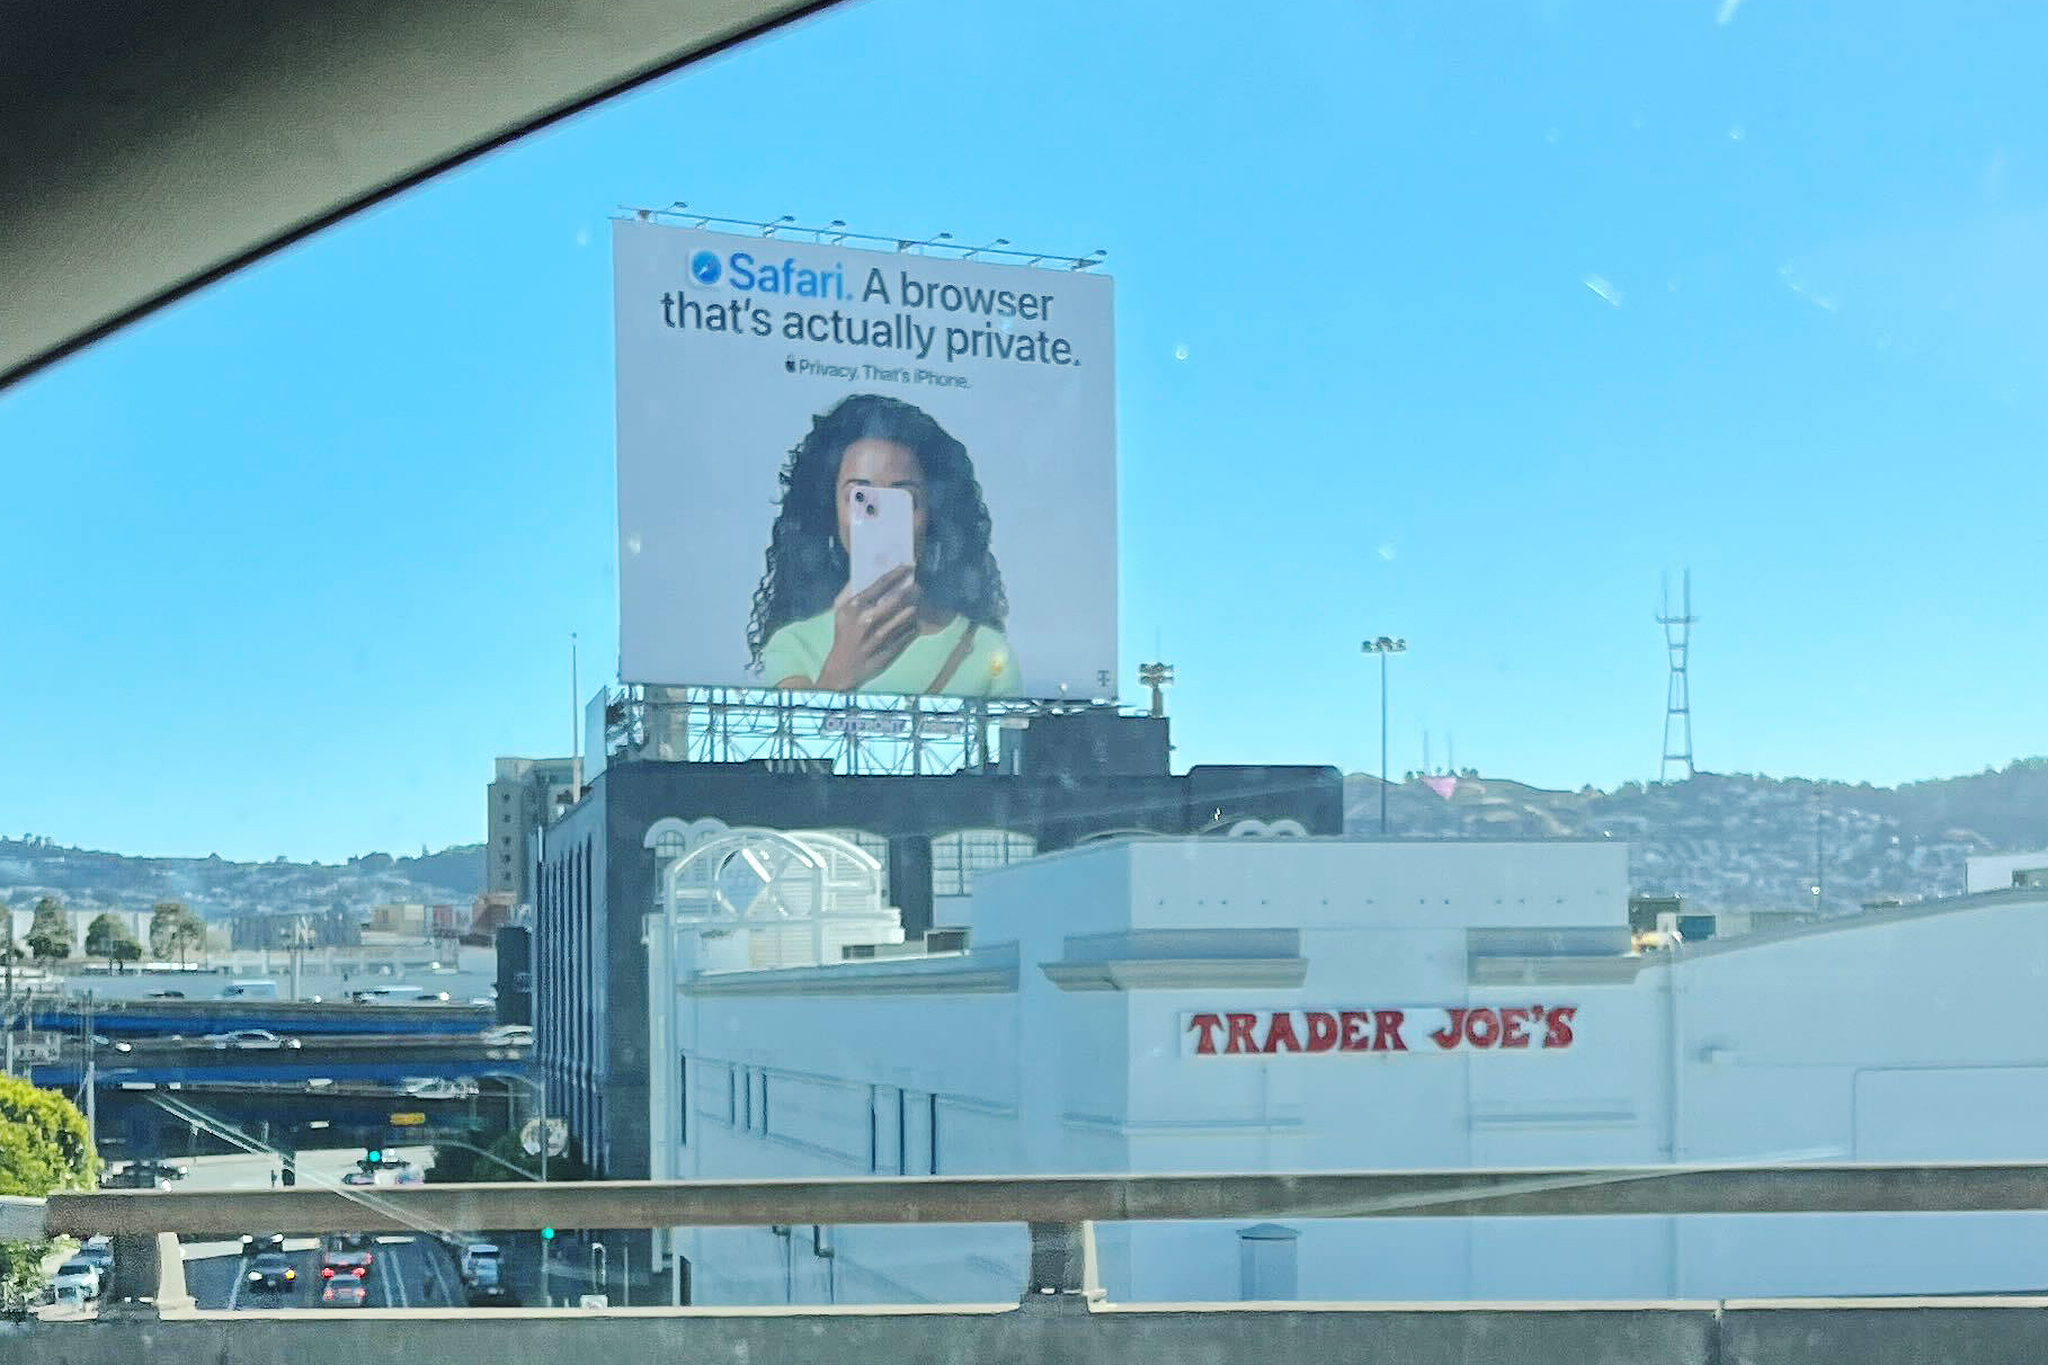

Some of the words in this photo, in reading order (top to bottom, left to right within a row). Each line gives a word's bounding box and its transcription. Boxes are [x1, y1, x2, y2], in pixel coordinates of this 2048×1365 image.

[729, 252, 854, 301] Safari.
[863, 267, 891, 305] A
[901, 271, 1054, 321] browser
[660, 290, 772, 337] that's
[783, 310, 936, 360] actually
[946, 321, 1082, 367] private.
[1187, 1010, 1408, 1054] TRADER
[1428, 1005, 1578, 1050] JOE'S
